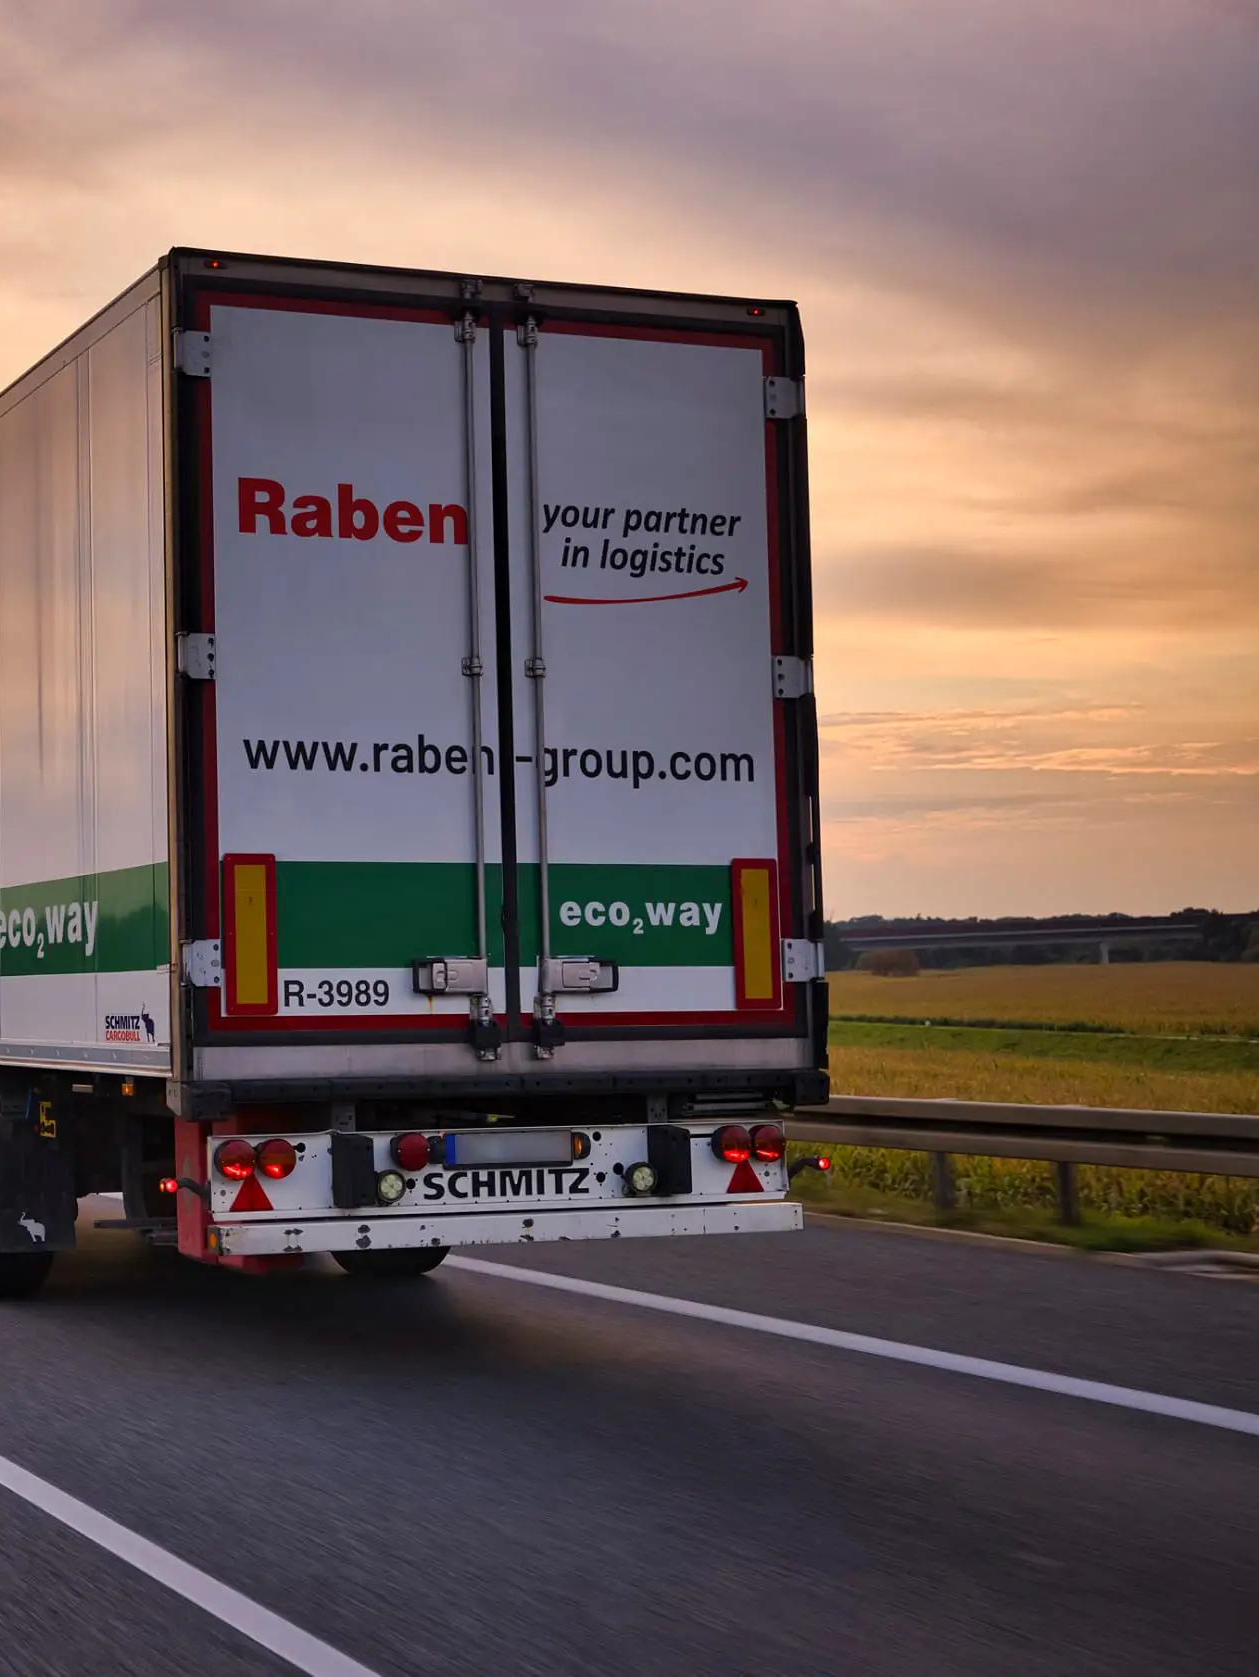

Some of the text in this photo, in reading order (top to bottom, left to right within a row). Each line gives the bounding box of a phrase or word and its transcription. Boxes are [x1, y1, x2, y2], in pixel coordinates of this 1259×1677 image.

[238, 477, 468, 545] Raben
[542, 504, 741, 538] your partner
[561, 537, 725, 578] in logistics
[283, 979, 389, 1007] R-3989
[105, 1015, 140, 1030] SCHMITZ
[106, 1030, 140, 1042] CARGOBULL
[423, 1167, 590, 1200] SCHMITZ
